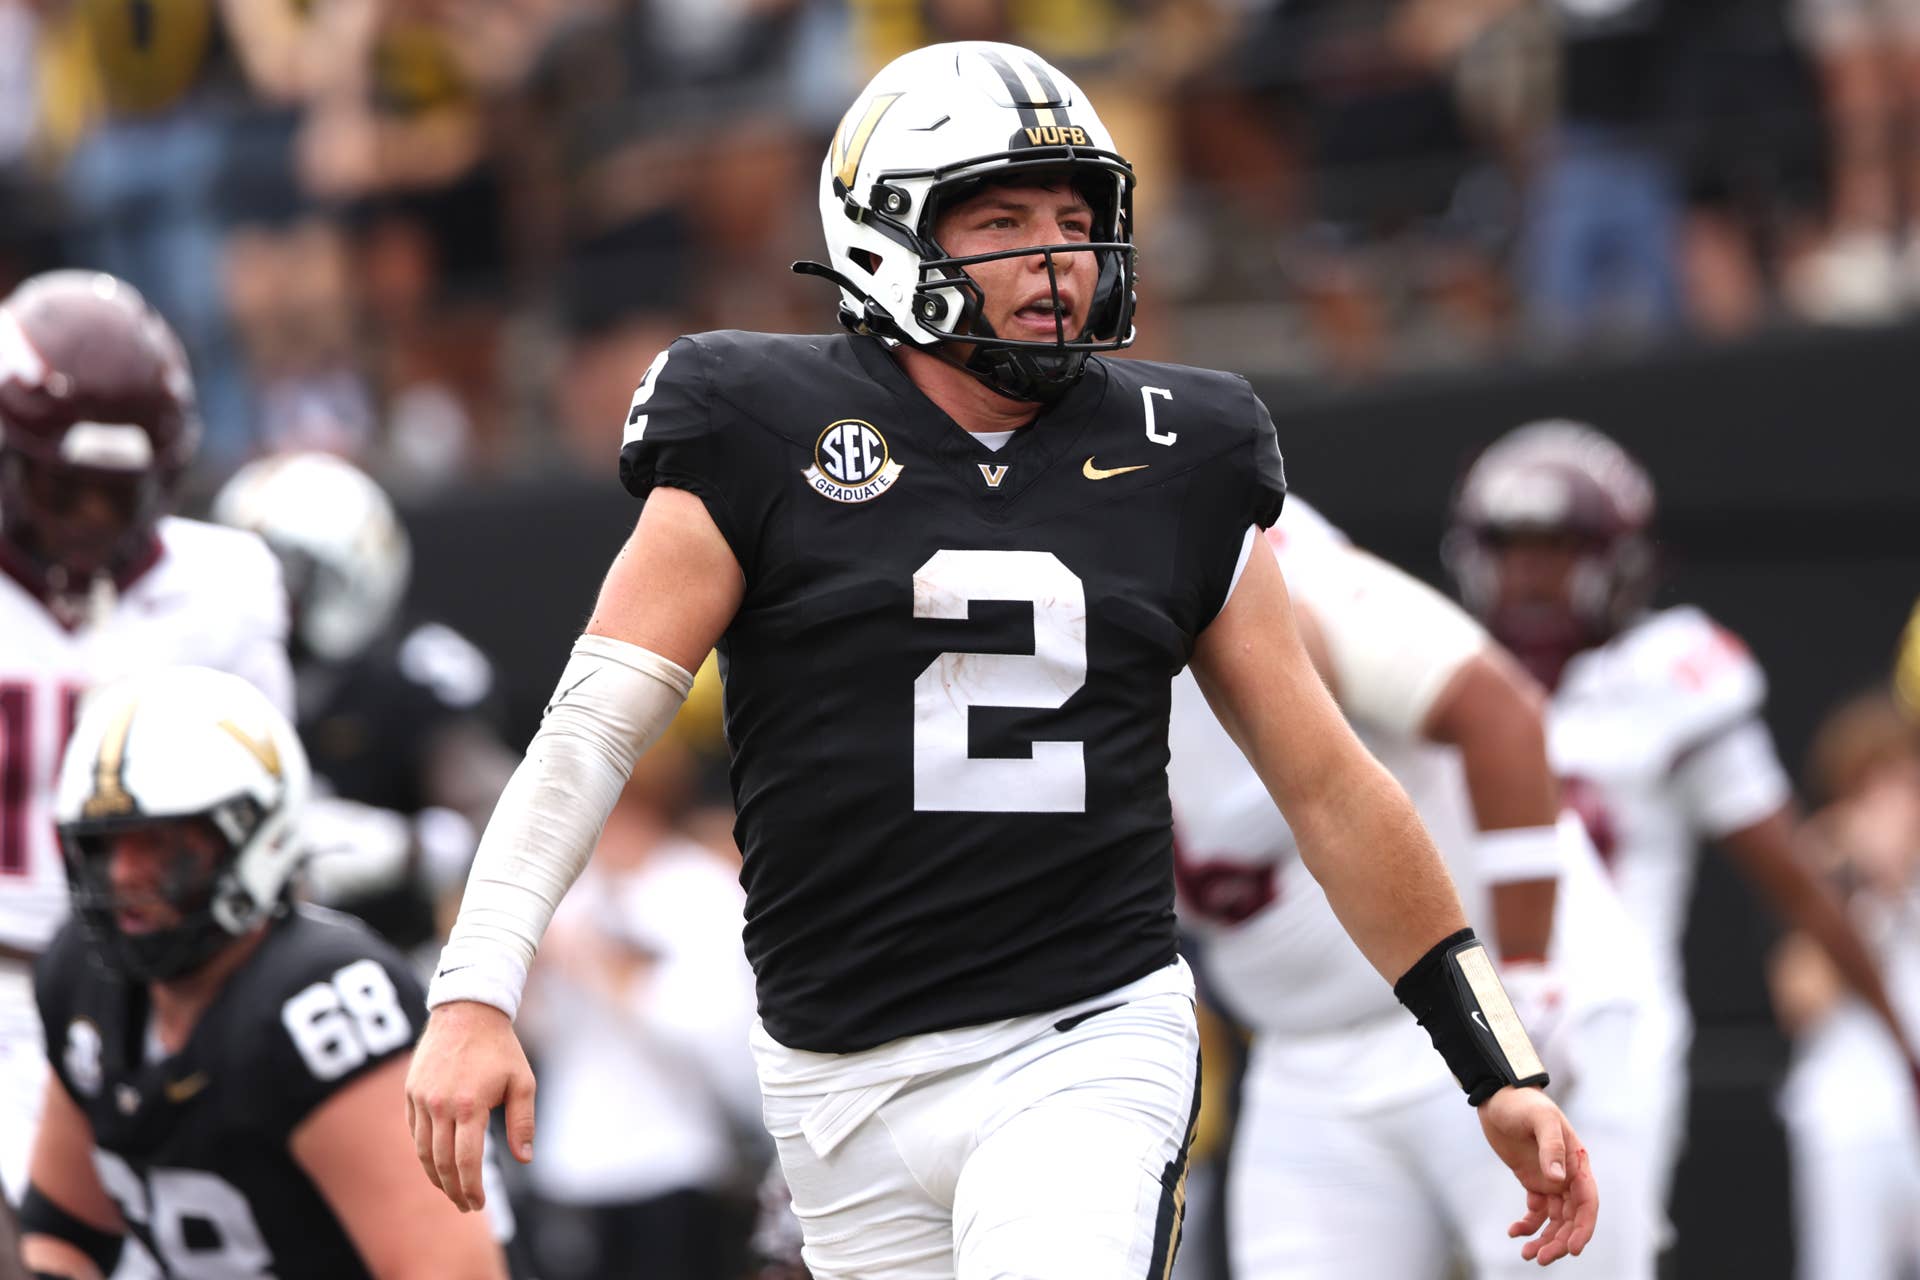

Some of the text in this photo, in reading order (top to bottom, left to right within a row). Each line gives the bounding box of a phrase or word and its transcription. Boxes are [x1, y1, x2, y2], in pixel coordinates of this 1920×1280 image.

[1024, 126, 1086, 146] VUFB
[621, 350, 669, 450] 2
[1140, 386, 1178, 446] C
[822, 424, 881, 480] SEC
[977, 463, 1009, 487] V
[815, 475, 890, 501] GRADUATE
[912, 549, 1087, 812] 2
[281, 958, 412, 1081] 68
